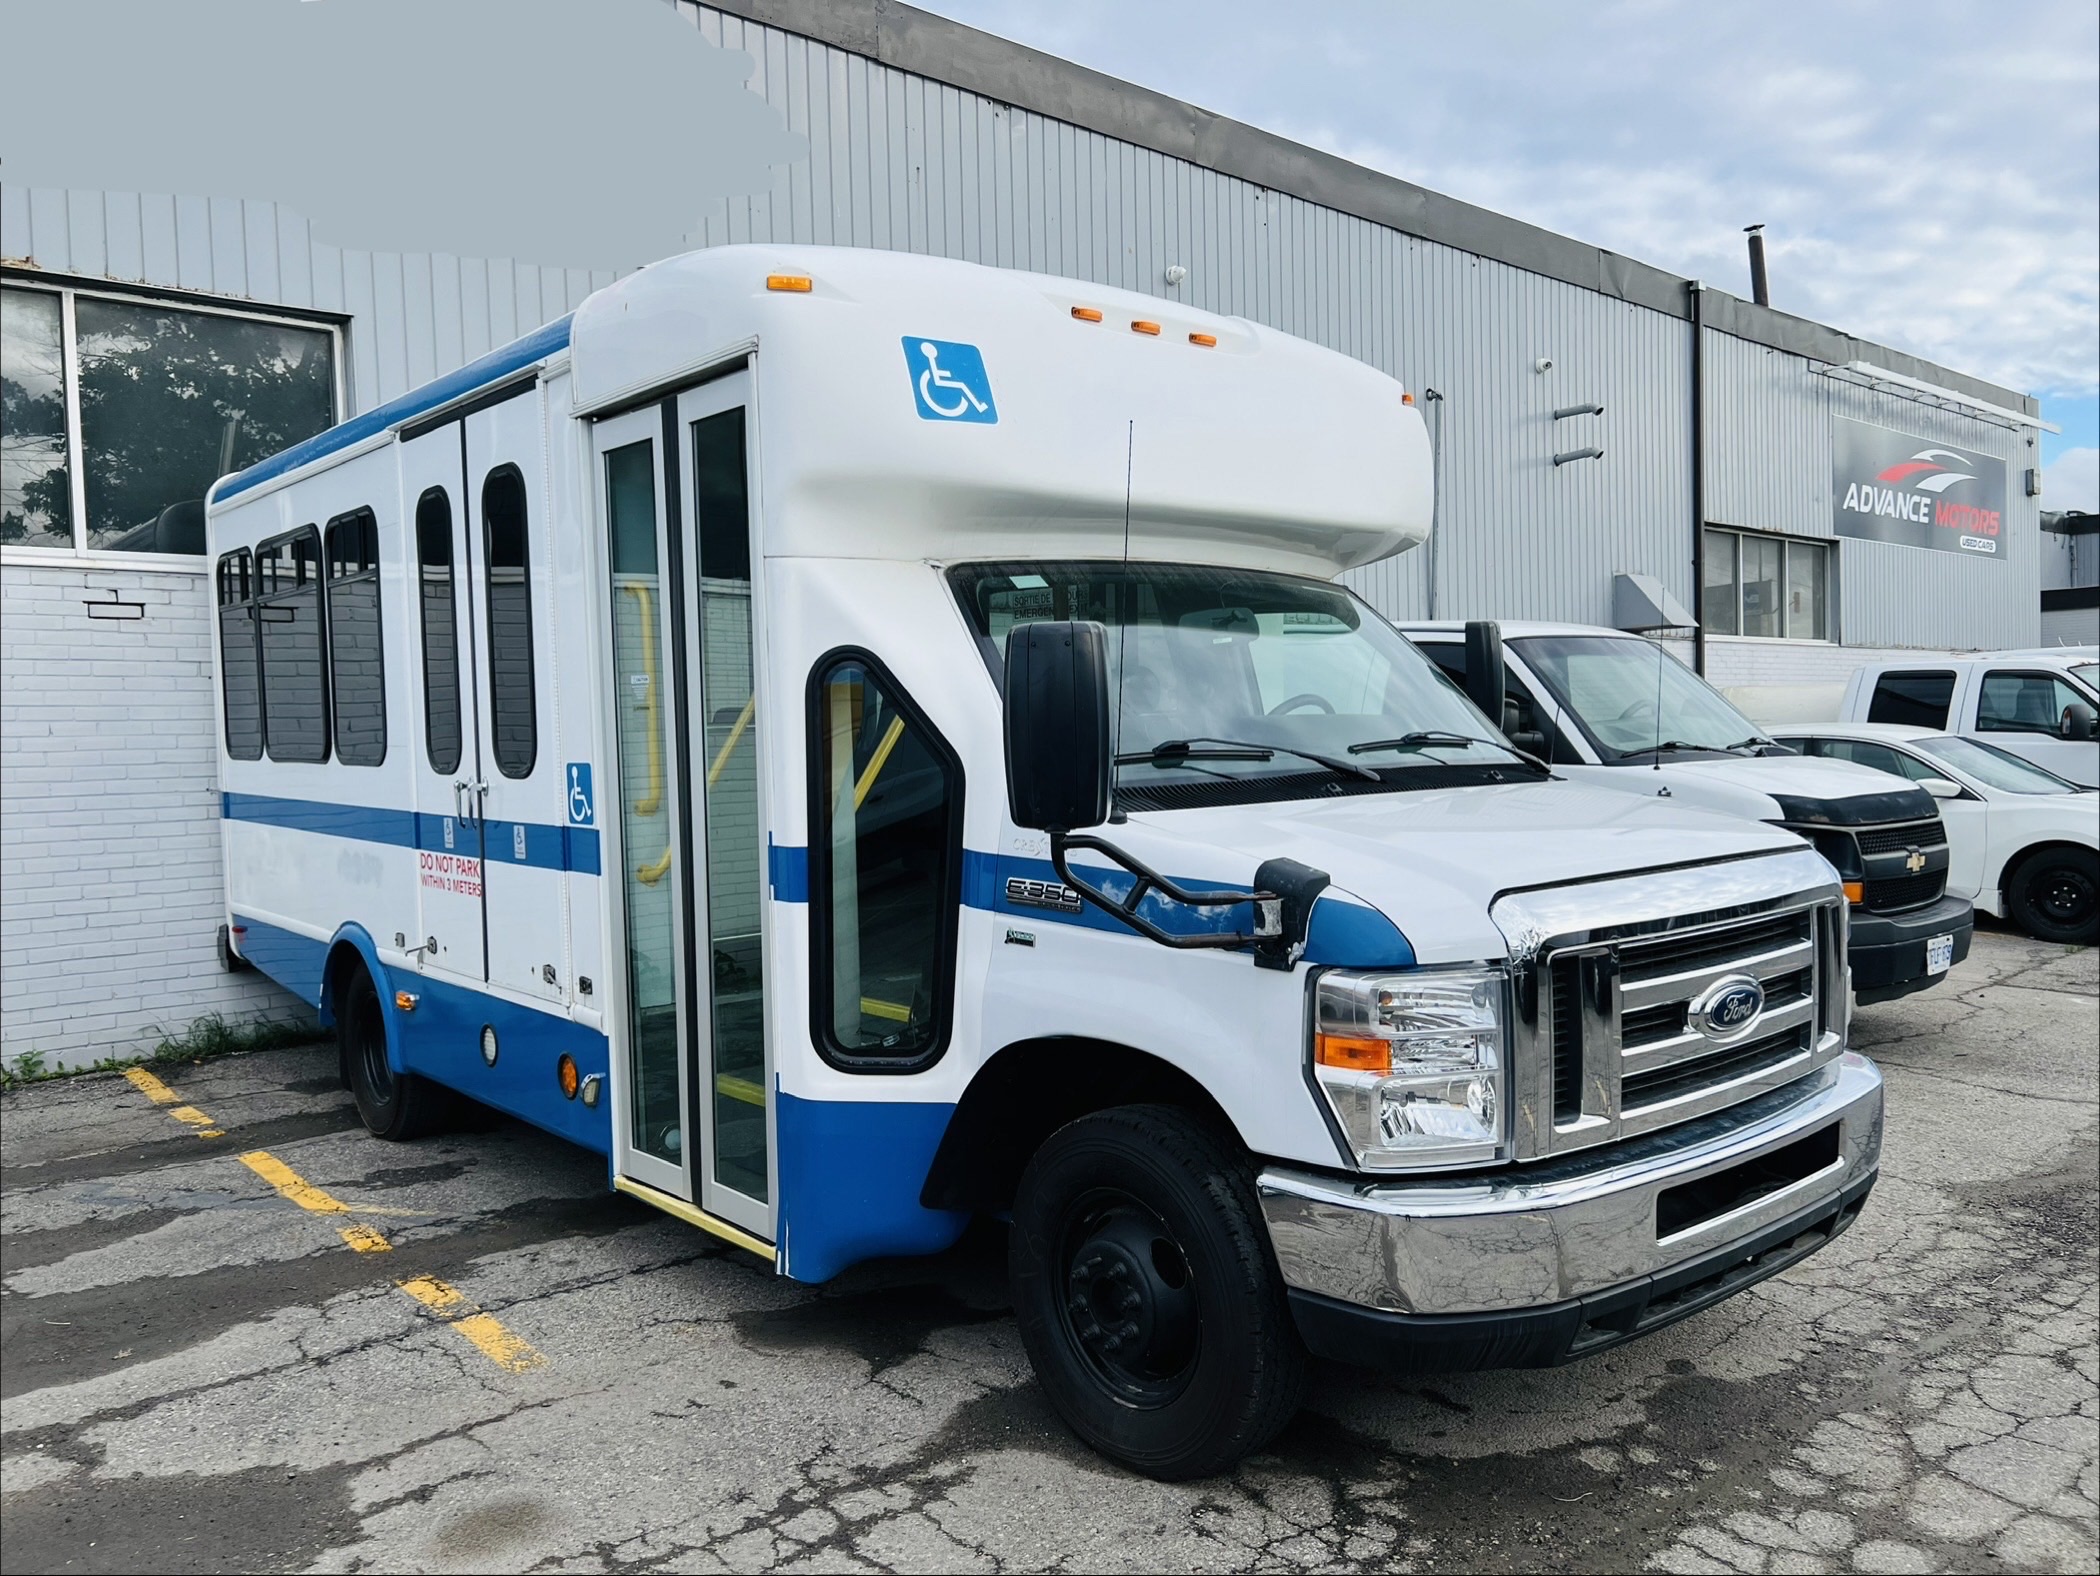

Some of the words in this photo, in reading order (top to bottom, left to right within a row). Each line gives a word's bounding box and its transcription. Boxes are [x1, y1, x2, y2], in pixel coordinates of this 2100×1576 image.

[1843, 482, 1932, 524] ADVANCE
[1935, 500, 2000, 536] MOTORS
[1962, 538, 1977, 548] USED
[1978, 540, 1994, 551] CARS
[1014, 594, 1040, 606] SORTIE
[1041, 593, 1051, 604] DE
[1014, 607, 1053, 619] EMERGEN
[420, 852, 434, 870] DO
[435, 855, 453, 874] NOT
[456, 857, 480, 879] PARK
[420, 874, 445, 891] WITHIN
[446, 878, 452, 891] 3
[453, 879, 482, 897] METERS
[1006, 878, 1081, 904] E-350
[1723, 993, 1754, 1023] Ford
